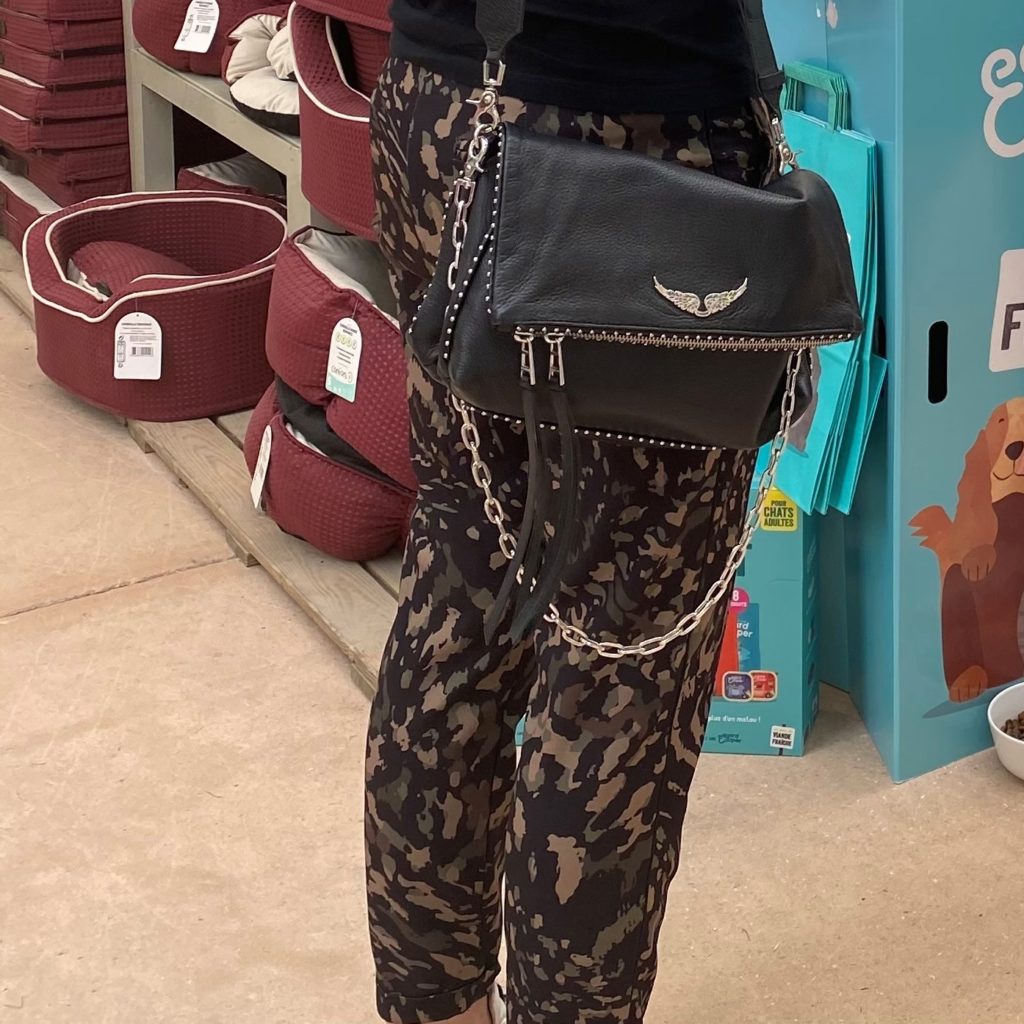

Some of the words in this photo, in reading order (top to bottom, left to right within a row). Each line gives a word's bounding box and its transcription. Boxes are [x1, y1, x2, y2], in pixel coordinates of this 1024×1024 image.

[763, 507, 794, 518] CHATS
[763, 518, 794, 527] ADULTES
[732, 590, 740, 601] 8
